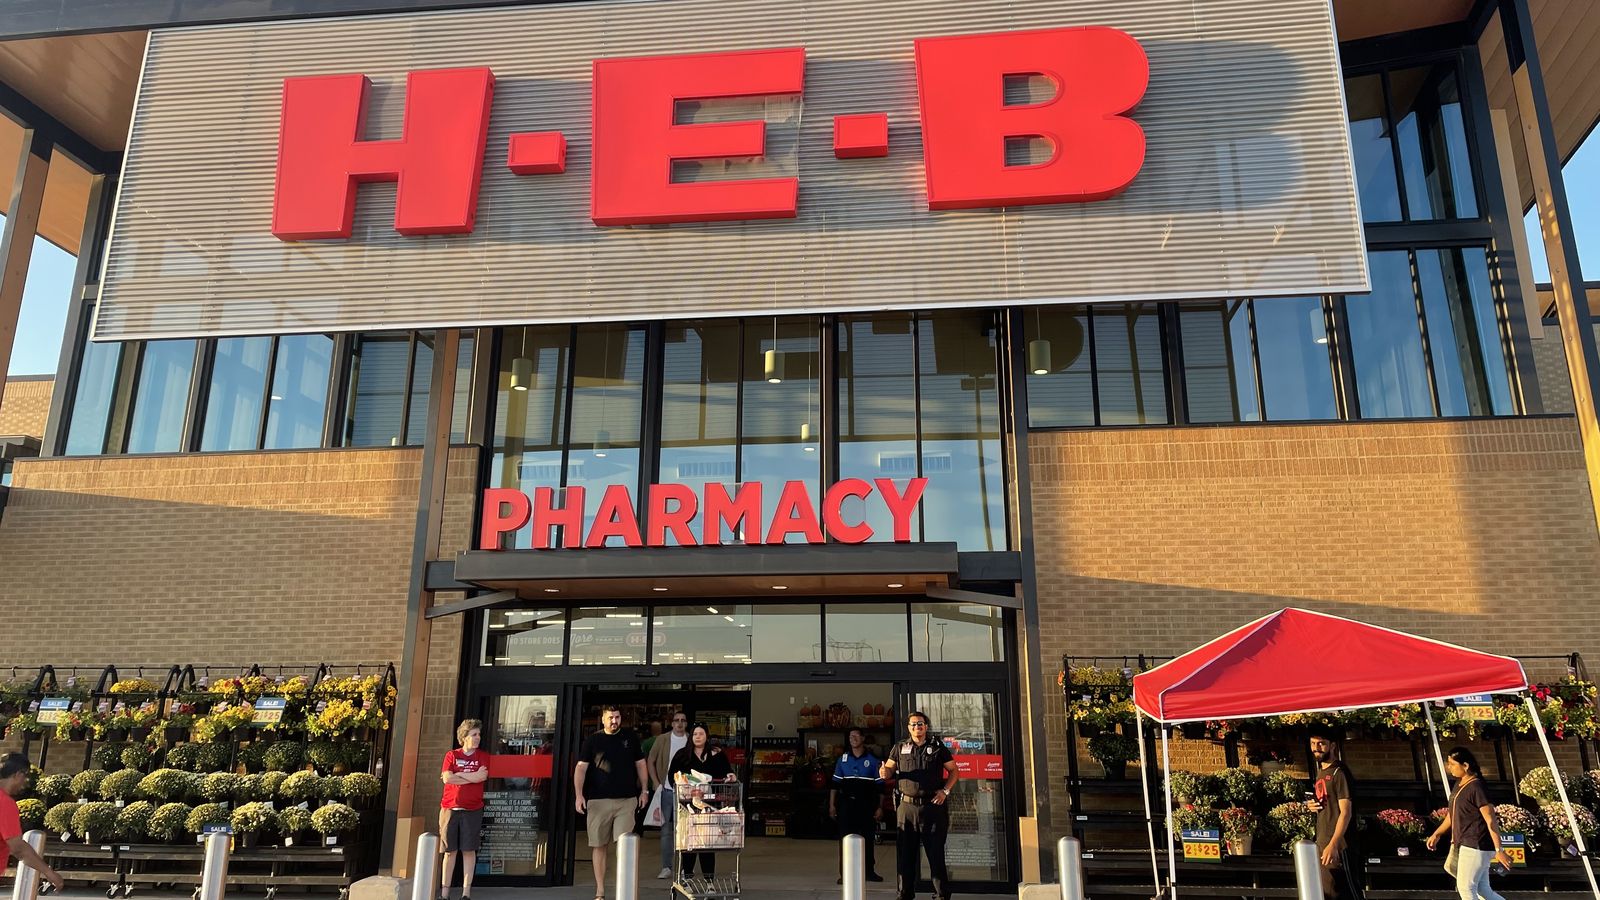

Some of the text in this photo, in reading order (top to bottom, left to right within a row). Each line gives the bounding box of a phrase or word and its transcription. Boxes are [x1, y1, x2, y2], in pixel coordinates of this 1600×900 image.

[480, 477, 929, 550] PHARMACY
[520, 636, 541, 645] STORE
[543, 636, 560, 645] DOES
[1185, 844, 1192, 855] 2
[1197, 843, 1219, 856] $25
